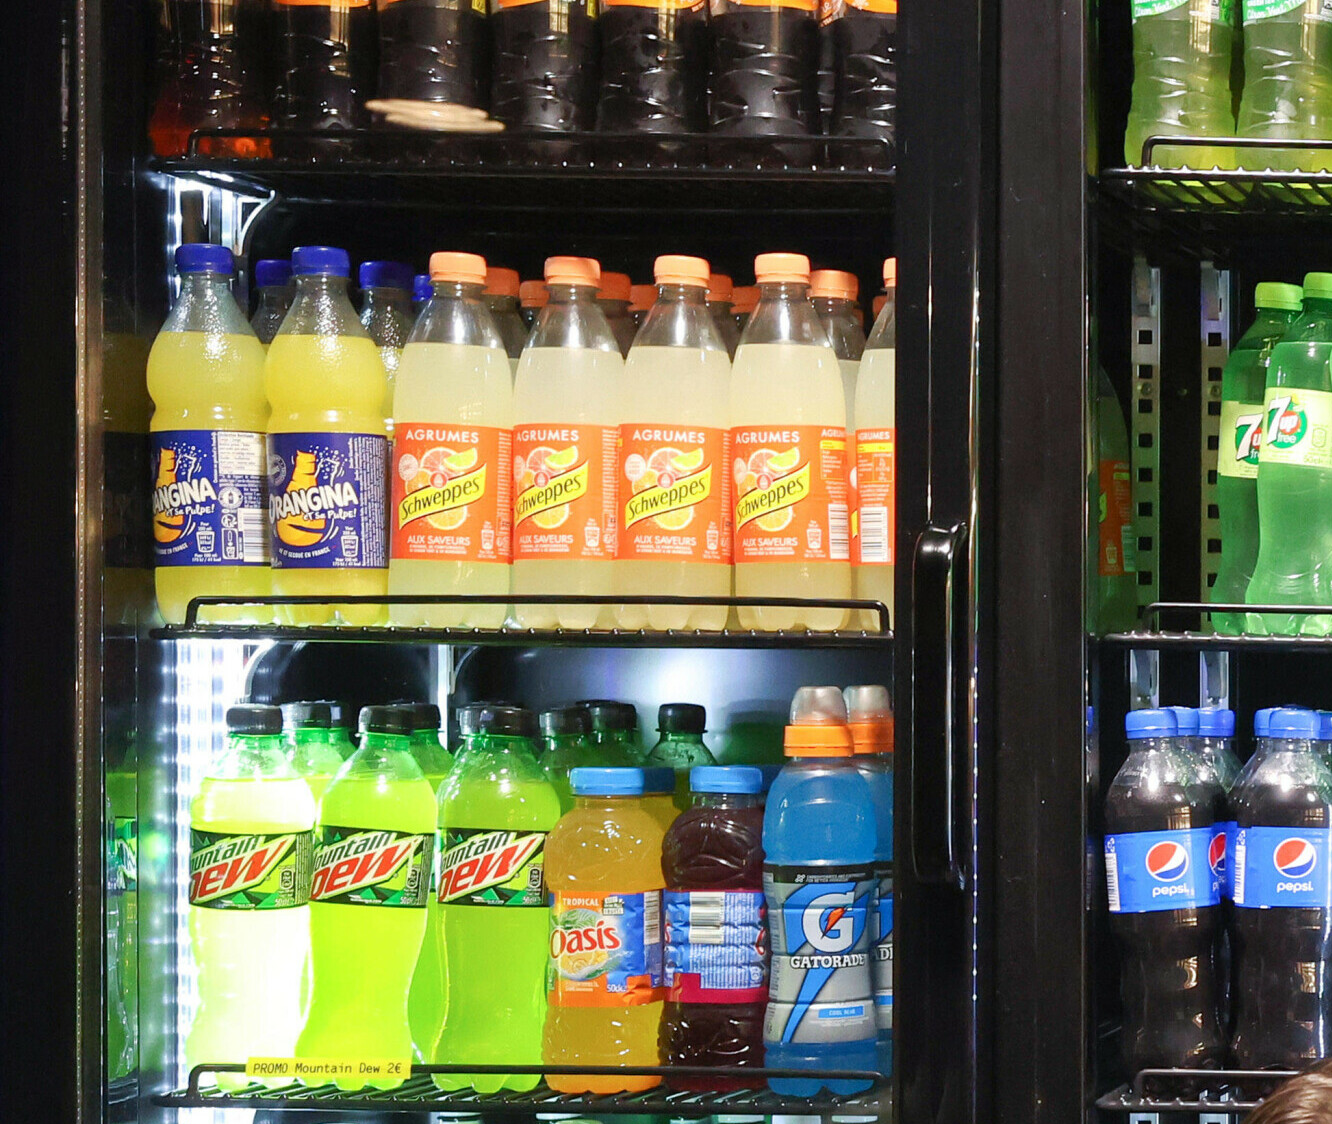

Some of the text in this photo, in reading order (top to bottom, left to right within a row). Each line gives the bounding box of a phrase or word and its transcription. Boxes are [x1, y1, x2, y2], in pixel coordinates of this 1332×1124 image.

[1268, 396, 1297, 445] 7 up
[405, 428, 479, 444] AGRUMES
[517, 429, 580, 442] AGRUMES
[632, 429, 705, 444] AGRUMES
[735, 431, 800, 444] AGRUMES
[1276, 433, 1297, 445] free
[268, 482, 359, 524] ORANGINA
[401, 477, 480, 520] Schweppes
[516, 475, 581, 517] Schweppes
[629, 478, 706, 520] Schweppes
[736, 477, 804, 521] Schweppes
[407, 535, 471, 546] AUX SAVEURS
[519, 534, 574, 544] AUX SAVEURS
[634, 535, 697, 547] AUX SAVEURS
[742, 537, 798, 547] AUX SAVEURS
[1152, 886, 1187, 898] pepsi
[1276, 881, 1311, 893] pepsi
[562, 897, 599, 907] TROPICAL
[802, 892, 855, 953] G
[550, 922, 621, 960] Oasis
[790, 955, 865, 970] GATORADE
[253, 1063, 402, 1074] PROMO Mountain Dew 2€
